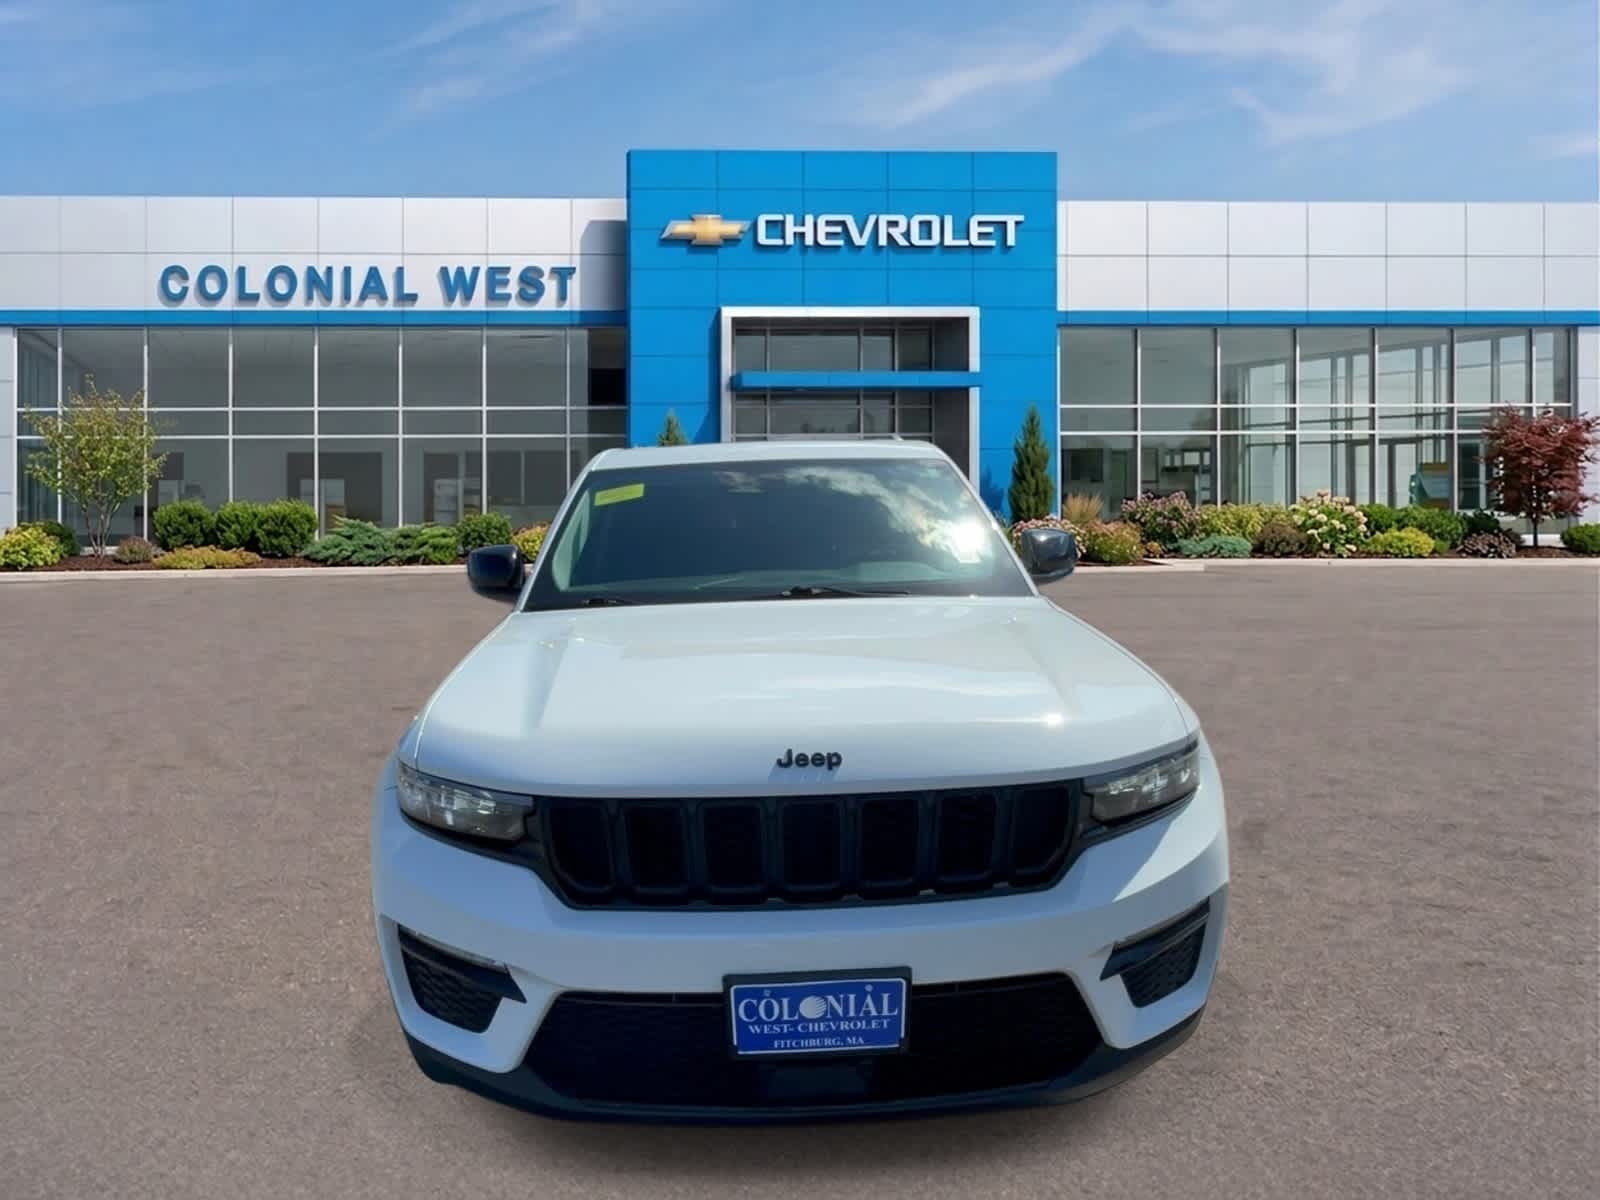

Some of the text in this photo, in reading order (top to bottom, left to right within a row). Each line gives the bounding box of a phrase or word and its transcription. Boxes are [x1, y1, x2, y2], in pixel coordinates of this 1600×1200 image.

[757, 214, 1024, 247] CHEVROLET
[160, 264, 577, 302] COLONIAL WEST
[776, 748, 843, 771] Jeep
[737, 993, 899, 1022] COLONIAL
[798, 1019, 891, 1033] CHEVROLET
[846, 1036, 865, 1046] MA
